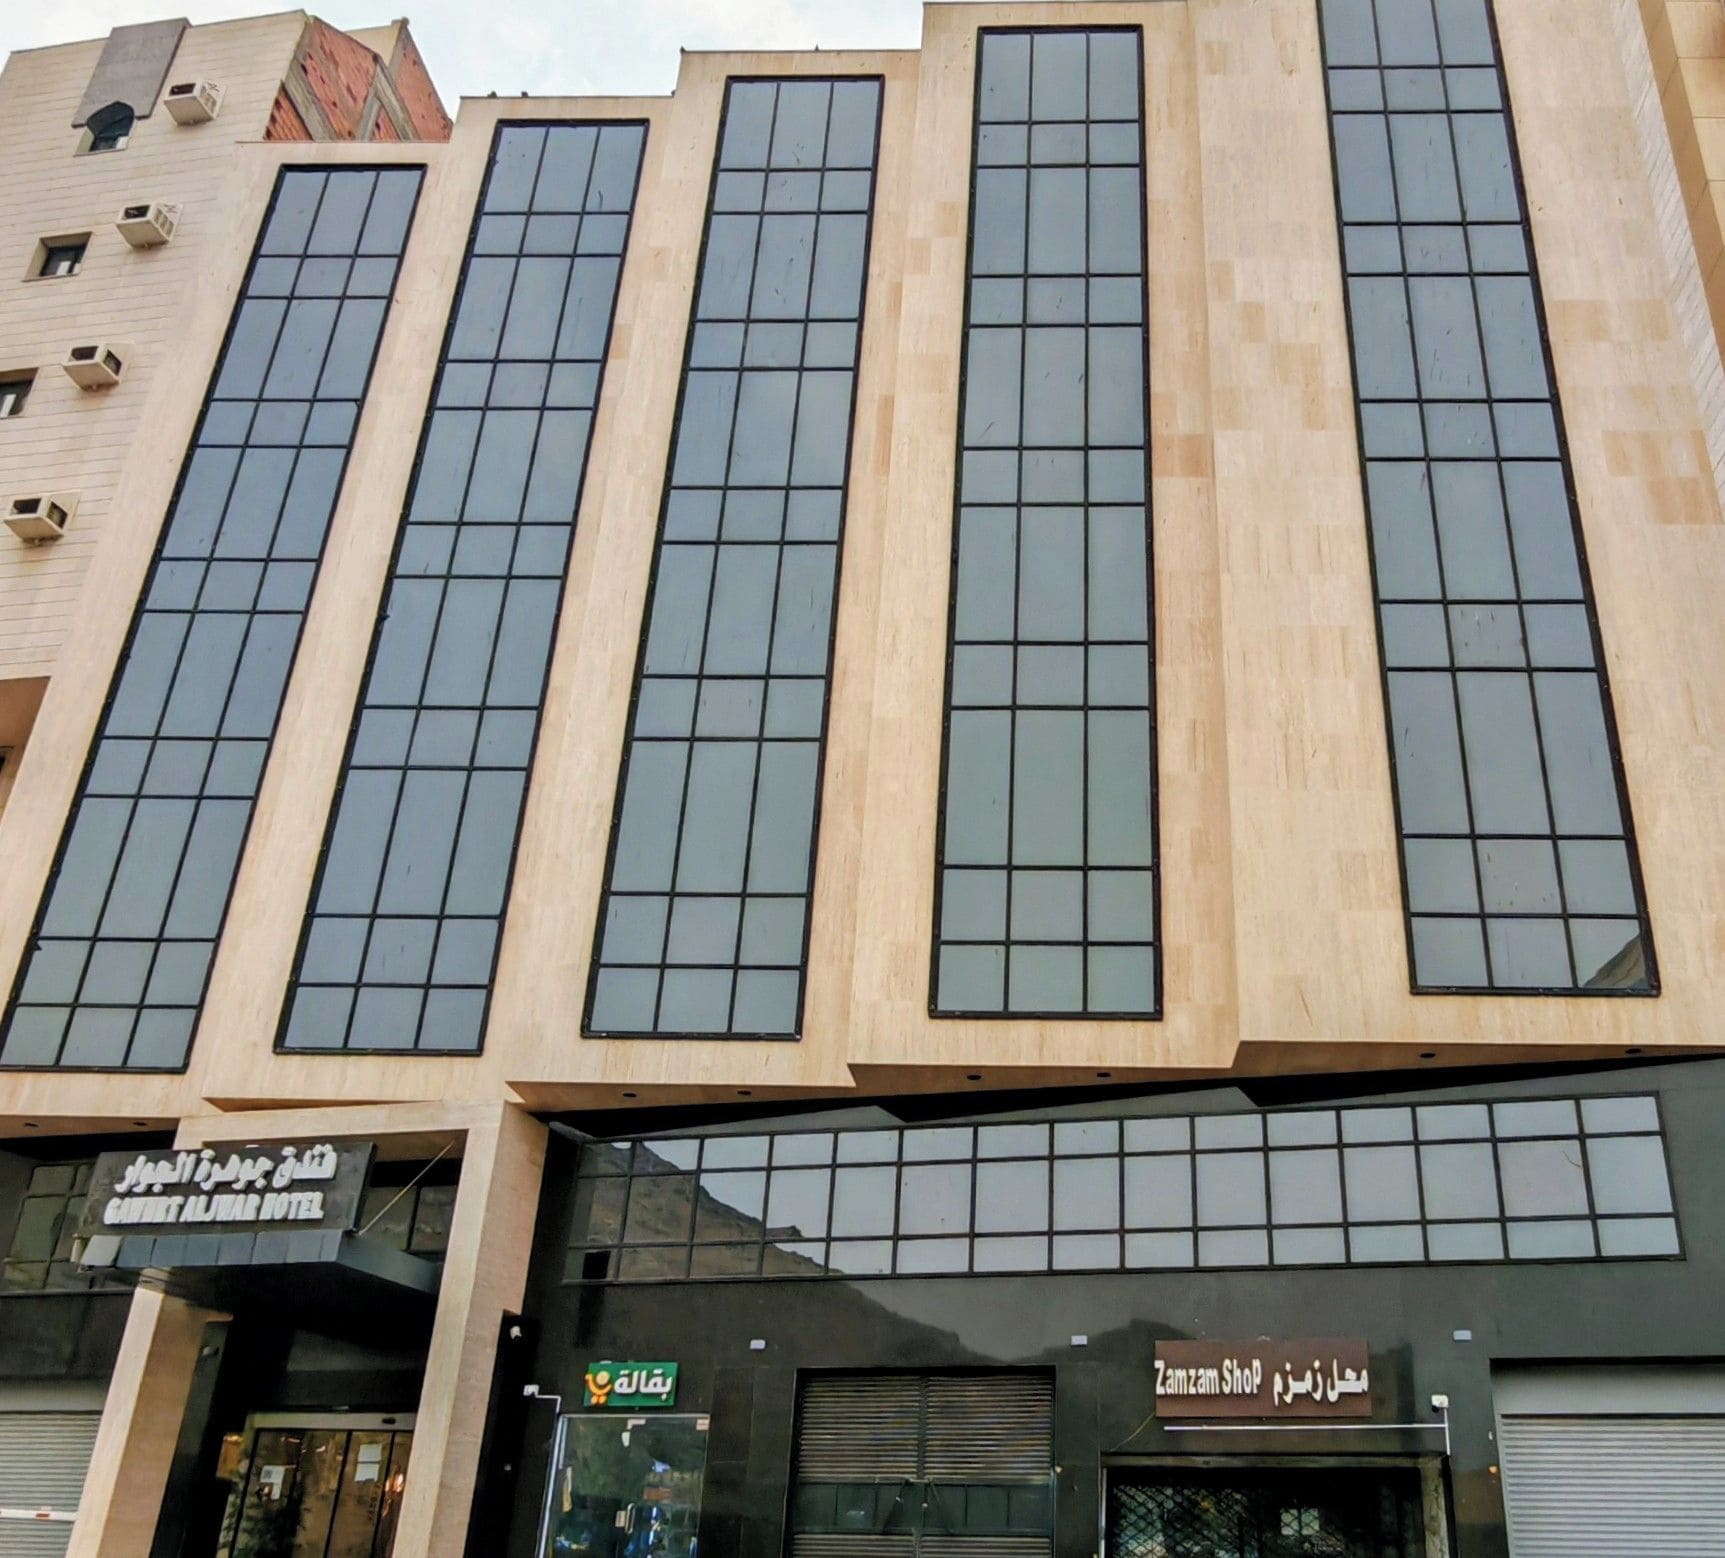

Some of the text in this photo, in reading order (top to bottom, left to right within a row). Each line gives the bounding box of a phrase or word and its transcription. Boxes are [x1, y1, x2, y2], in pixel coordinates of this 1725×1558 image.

[114, 1150, 198, 1194] الجوار
[271, 1143, 338, 1189] فندق
[259, 1191, 325, 1221] HOTEL
[613, 1368, 672, 1402] بقالة
[1154, 1359, 1220, 1395] Zamzam
[1273, 1358, 1369, 1407] محل زمزم
